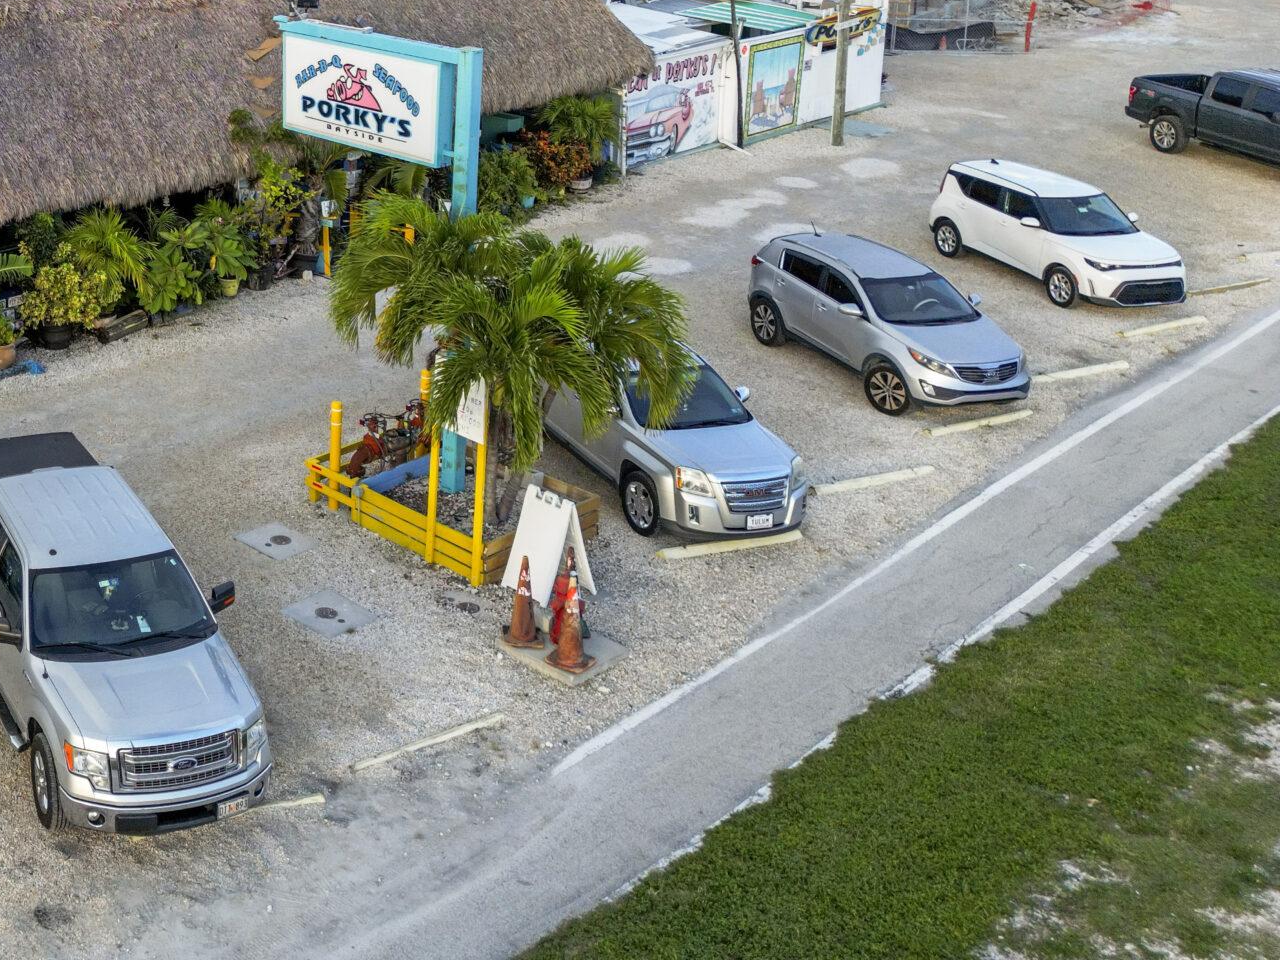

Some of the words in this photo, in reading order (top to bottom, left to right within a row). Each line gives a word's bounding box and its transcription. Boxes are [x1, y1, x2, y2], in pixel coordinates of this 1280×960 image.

[294, 54, 343, 88] BAR-B-Q
[372, 62, 421, 117] SEAFOOD
[301, 95, 412, 138] PORKY'S
[327, 124, 384, 143] BAYSIDE
